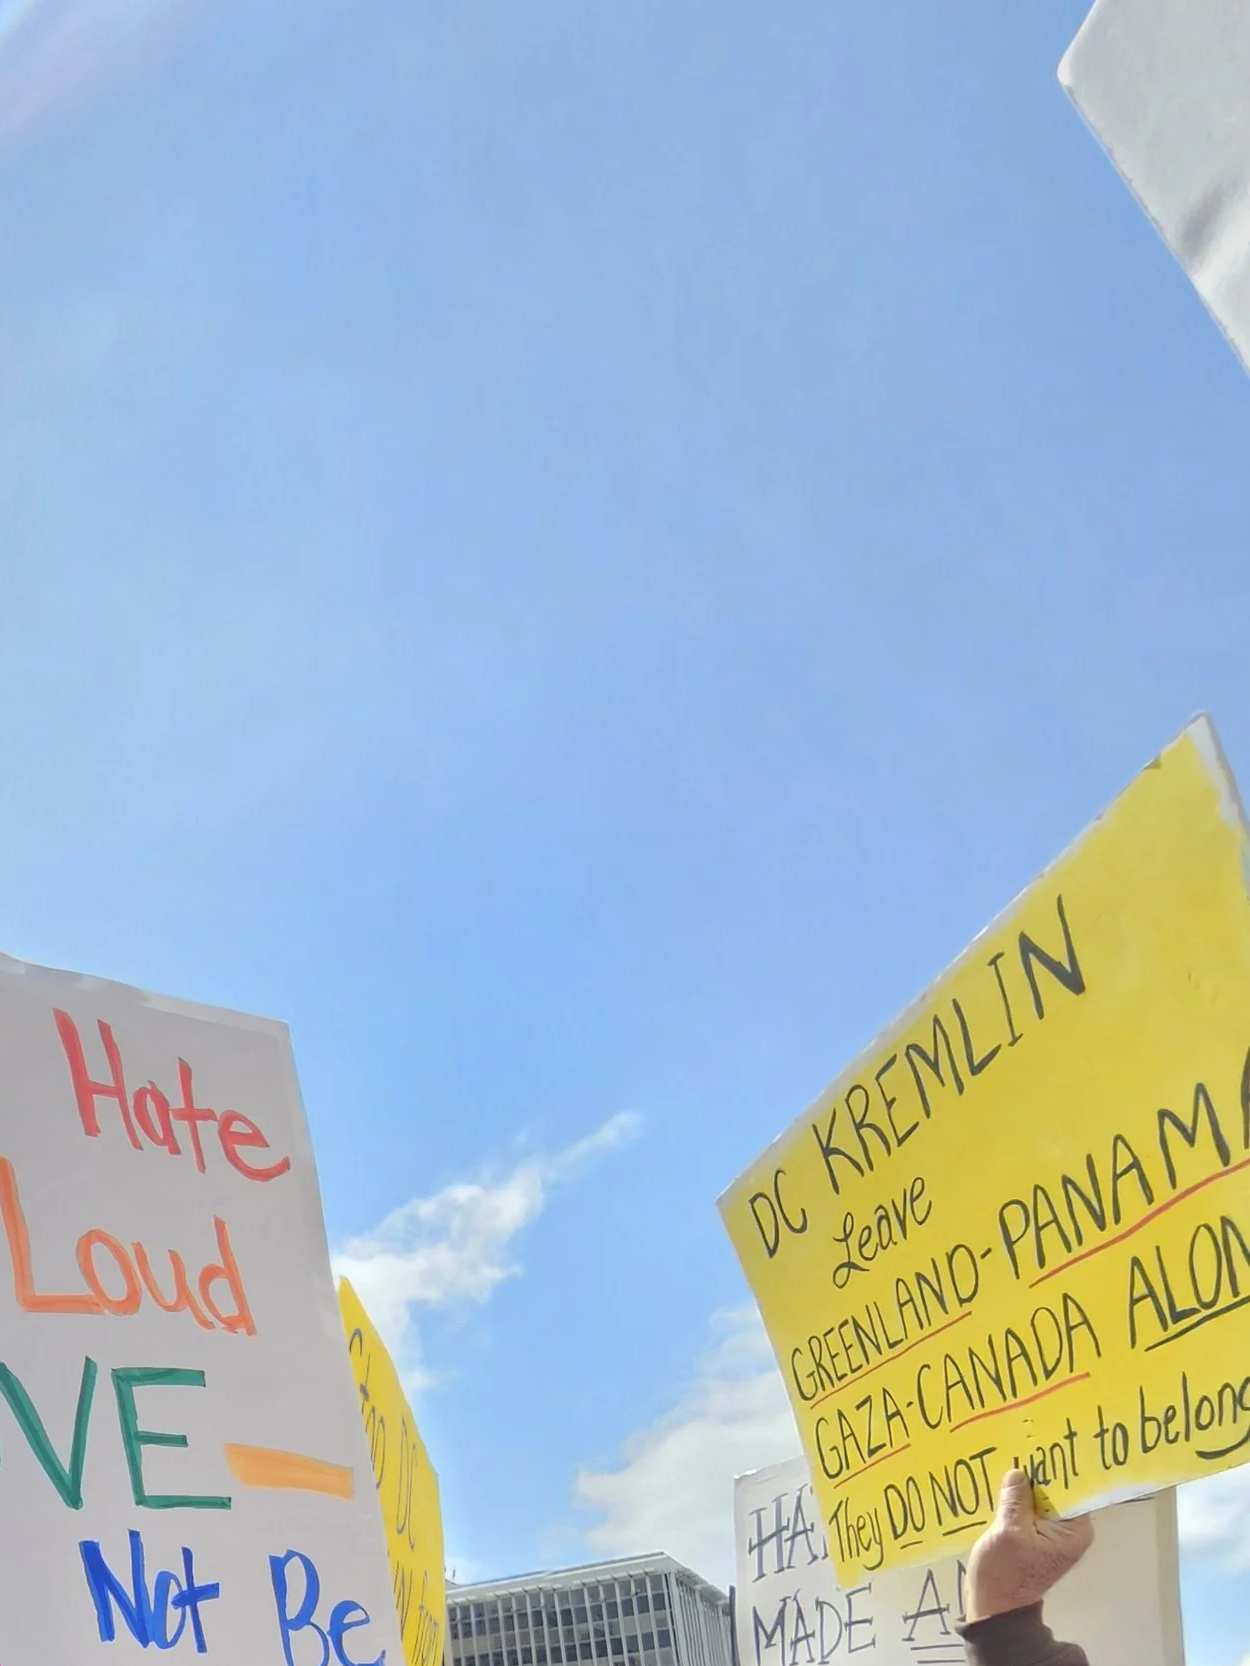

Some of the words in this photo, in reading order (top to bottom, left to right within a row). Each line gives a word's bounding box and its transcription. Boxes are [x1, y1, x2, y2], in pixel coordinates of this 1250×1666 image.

[53, 1009, 291, 1183] Hate
[749, 1168, 808, 1259] DC
[812, 894, 1086, 1195] KREMLIN
[791, 1045, 1250, 1402] GREENLAND-PANAM
[1129, 1216, 1250, 1349] ALON
[829, 1497, 884, 1572] They
[884, 1476, 927, 1541] DO
[930, 1446, 998, 1527] NOT
[1094, 1405, 1129, 1470] to
[79, 1529, 221, 1655] Not
